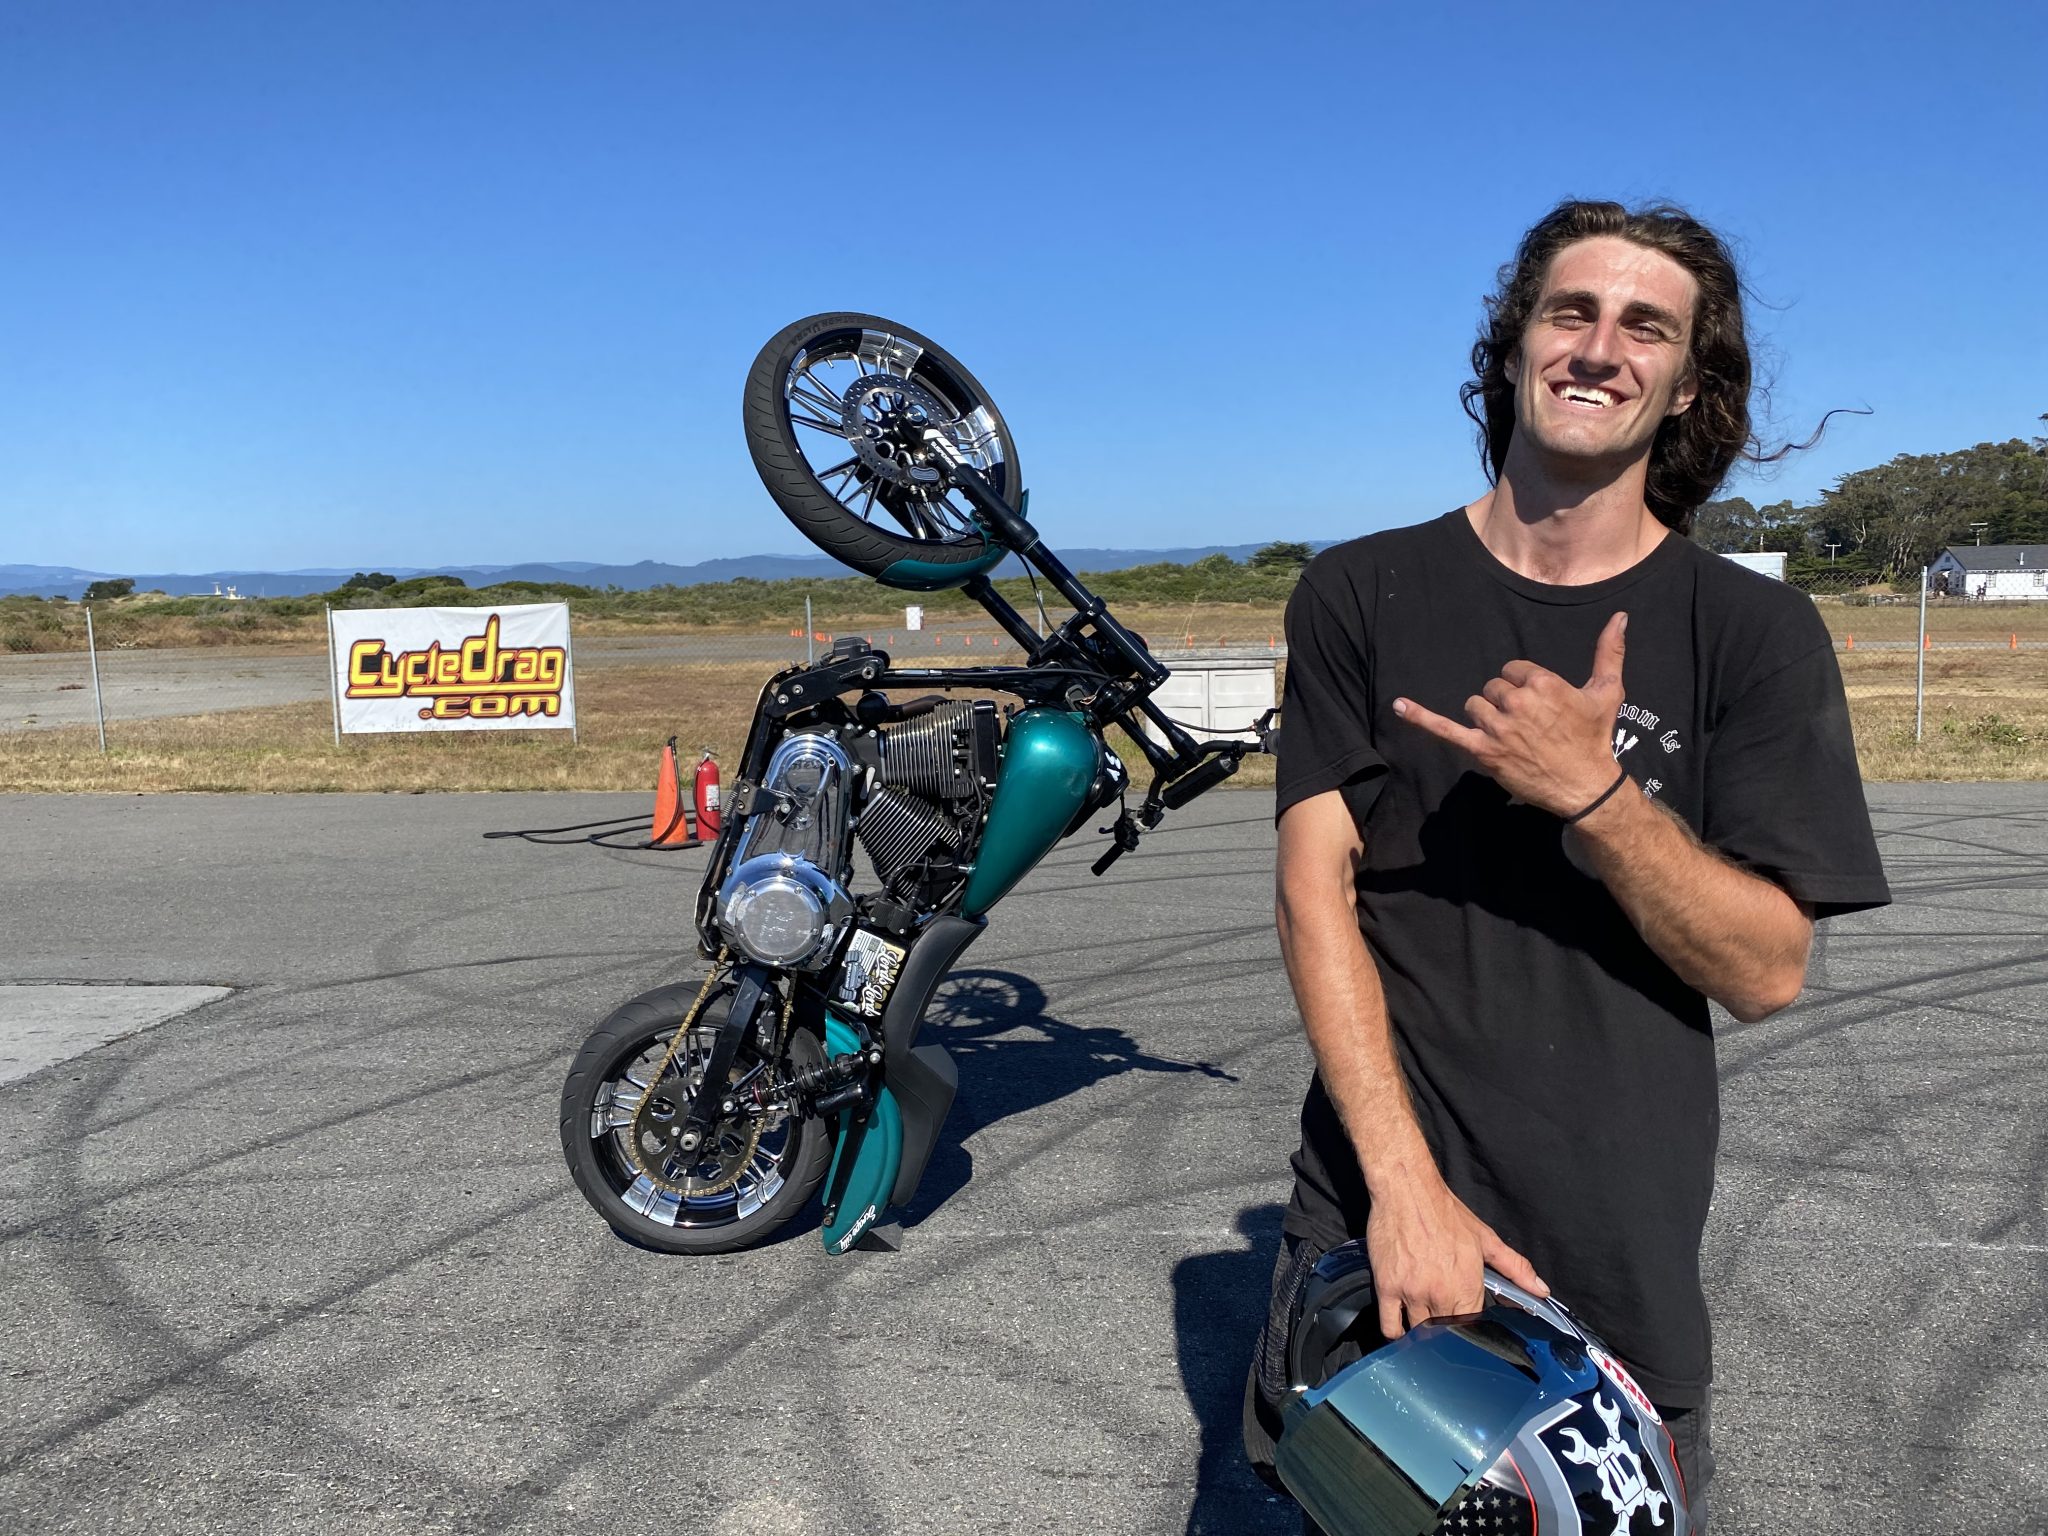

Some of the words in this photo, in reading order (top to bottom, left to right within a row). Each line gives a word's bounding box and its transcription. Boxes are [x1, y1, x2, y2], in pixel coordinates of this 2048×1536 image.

[345, 613, 565, 698] CycleDrag
[418, 691, 561, 719] .com
[1598, 1353, 1652, 1414] BELL
